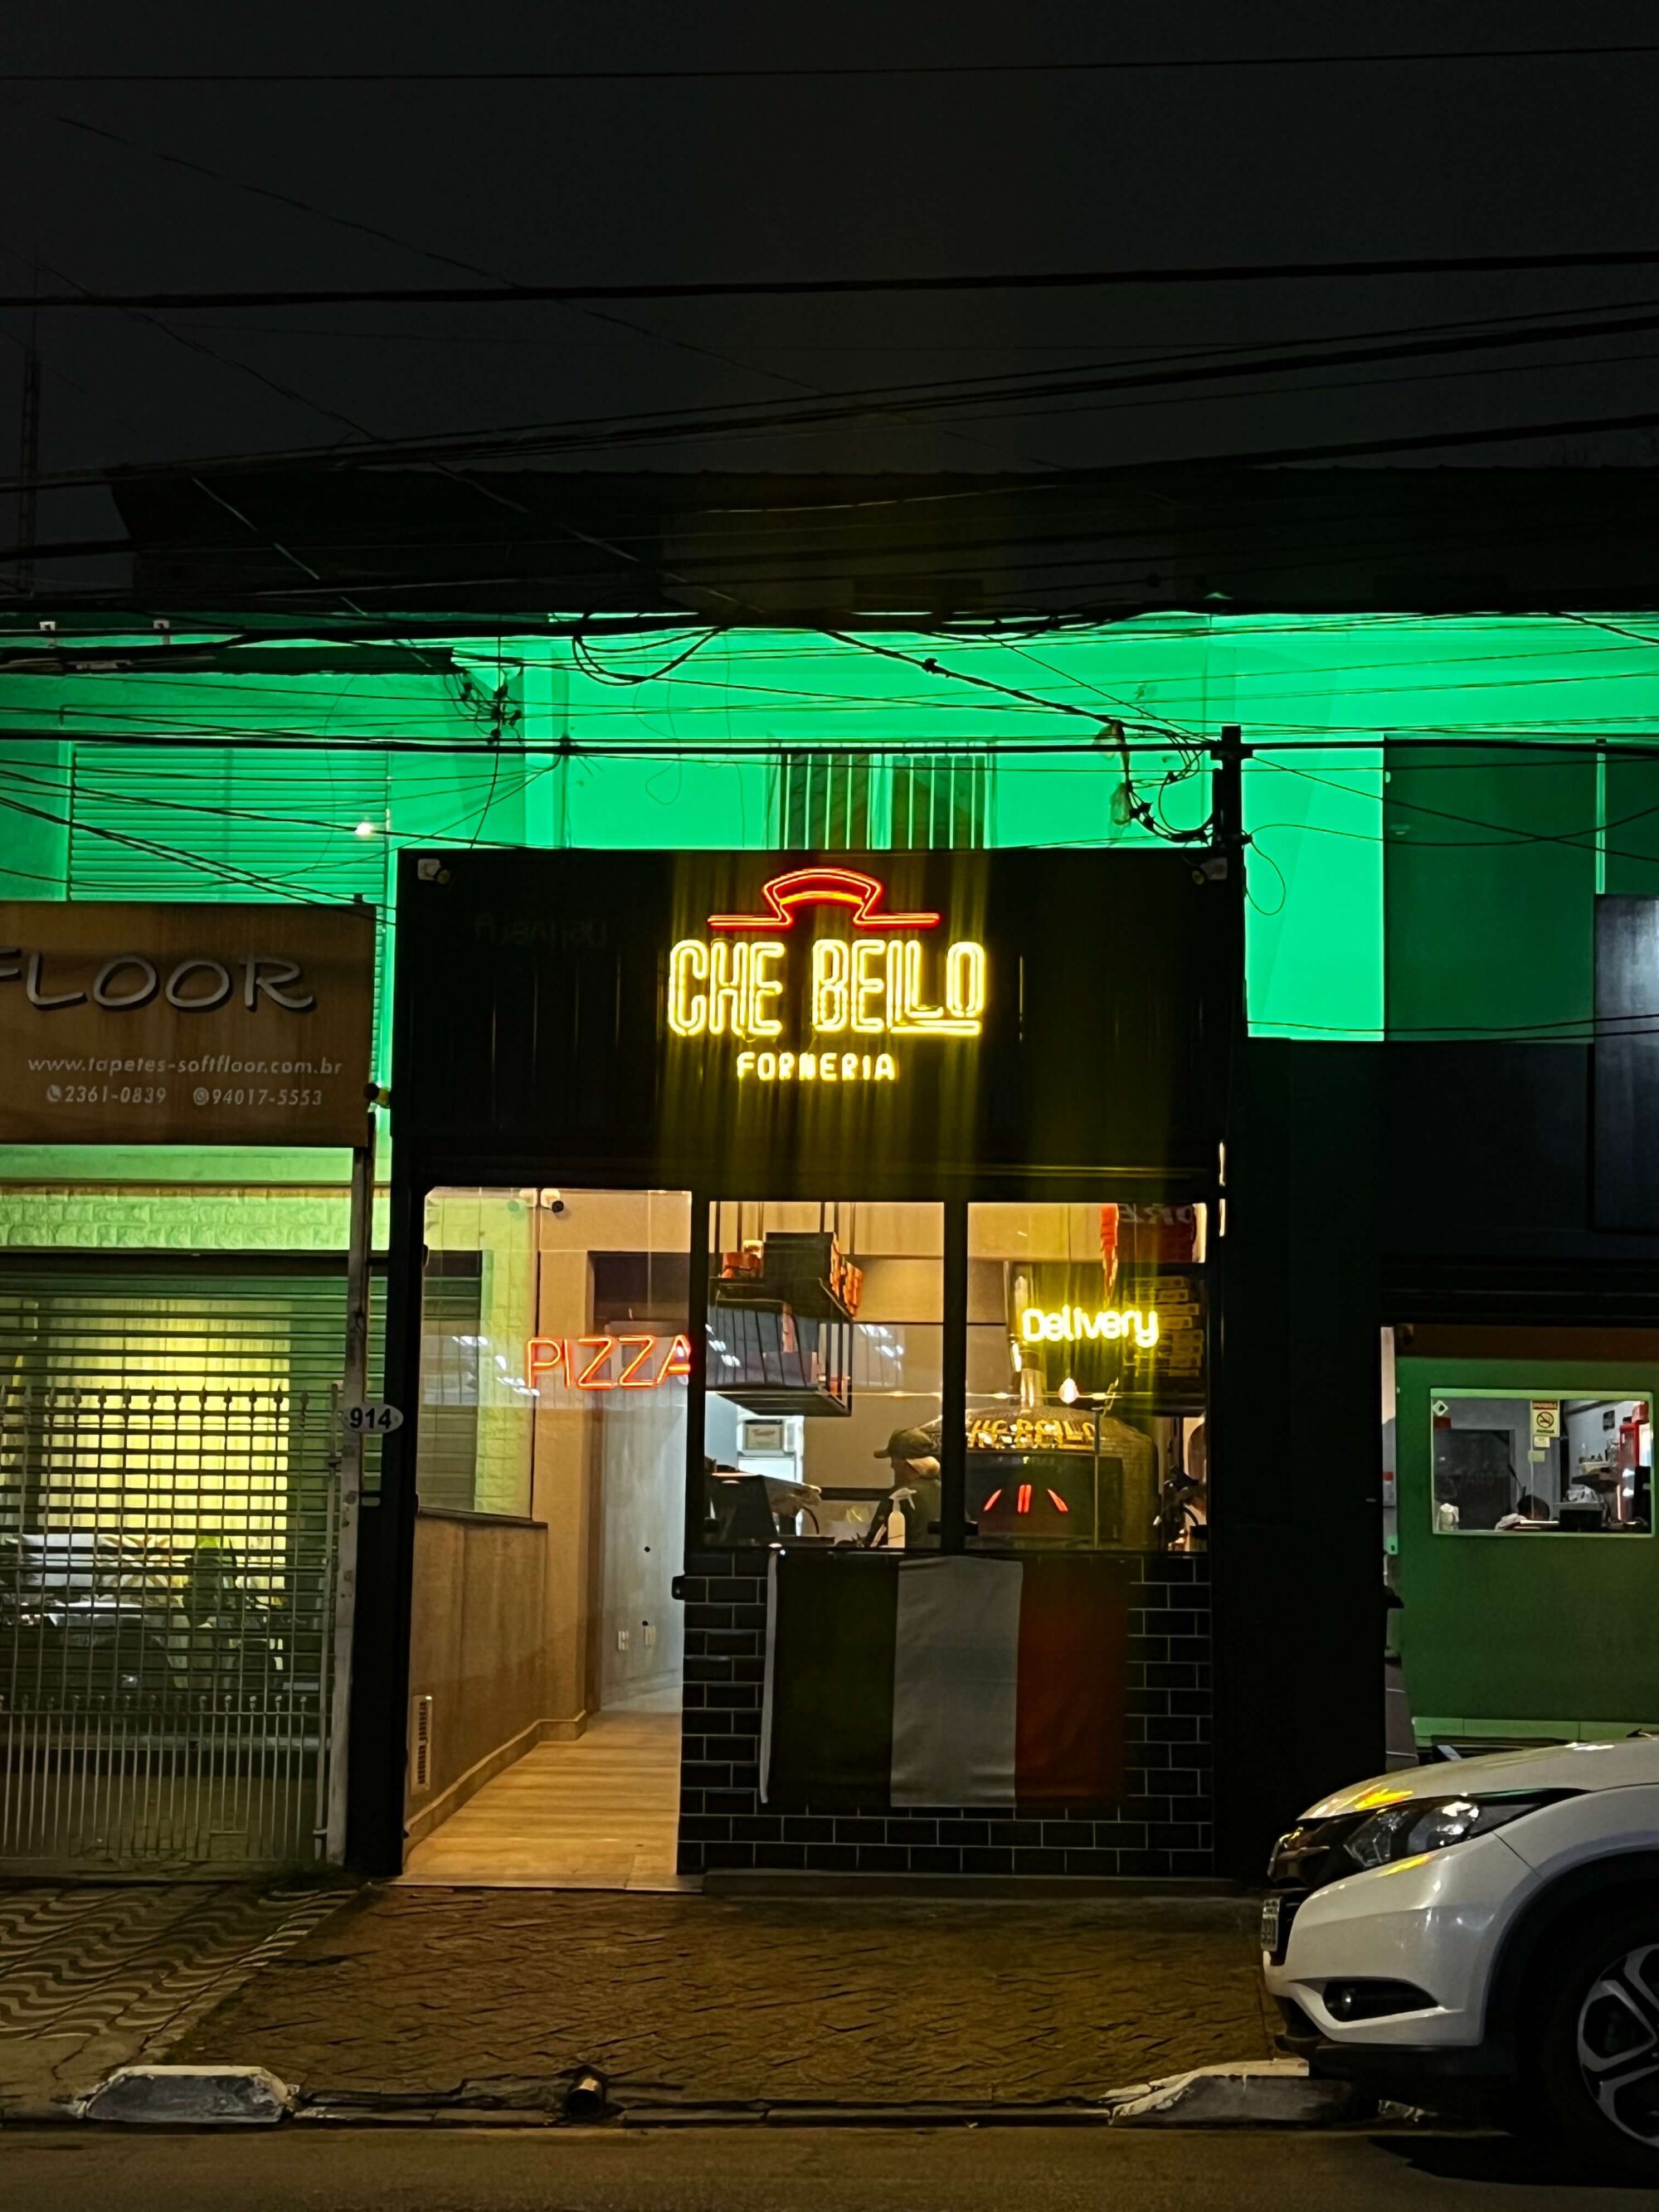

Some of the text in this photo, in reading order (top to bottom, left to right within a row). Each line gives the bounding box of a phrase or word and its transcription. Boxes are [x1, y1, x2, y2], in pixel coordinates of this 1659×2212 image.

[668, 938, 986, 1037] CHE BELLO
[27, 1054, 343, 1077] www.tapetes-softfloor.com.br
[736, 1051, 896, 1082] FORNERIA
[64, 1085, 323, 1106] 2361-0839 94017-5553
[1020, 1304, 1160, 1349] Delivery
[526, 1334, 692, 1391] PIZZA
[349, 1407, 392, 1430] 914
